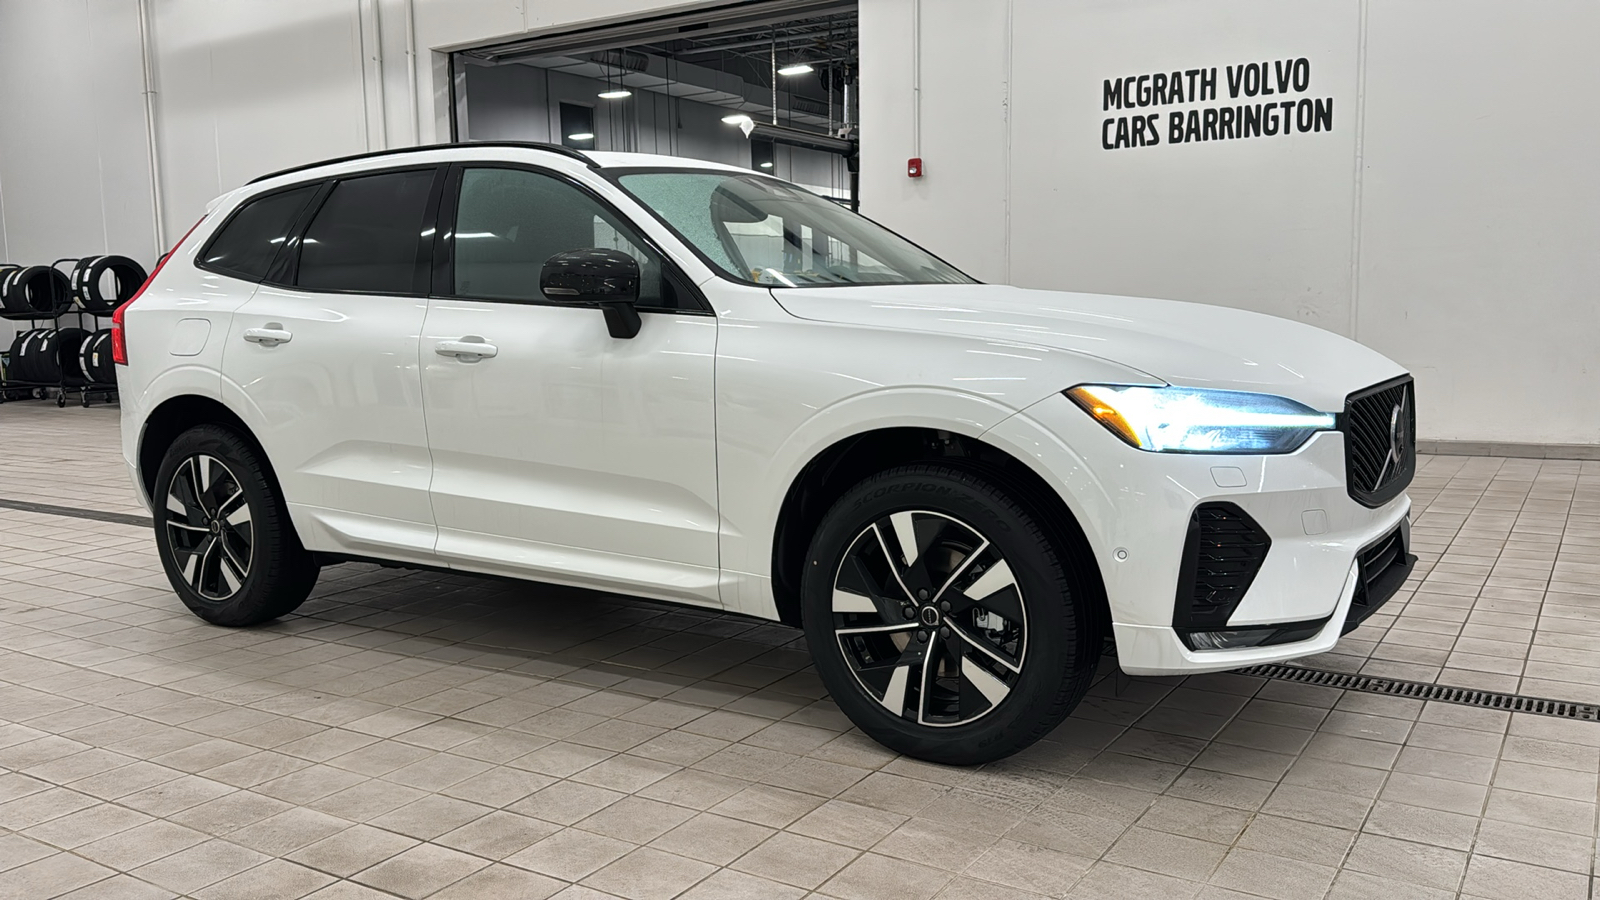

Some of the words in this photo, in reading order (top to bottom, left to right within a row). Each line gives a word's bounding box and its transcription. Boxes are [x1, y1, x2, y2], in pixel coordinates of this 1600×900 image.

[1102, 67, 1217, 111] MCGRATH
[1226, 57, 1310, 98] VOLVO
[1101, 113, 1160, 150] CARS
[1168, 97, 1333, 144] BARRINGTON
[853, 482, 952, 509] SCORPION
